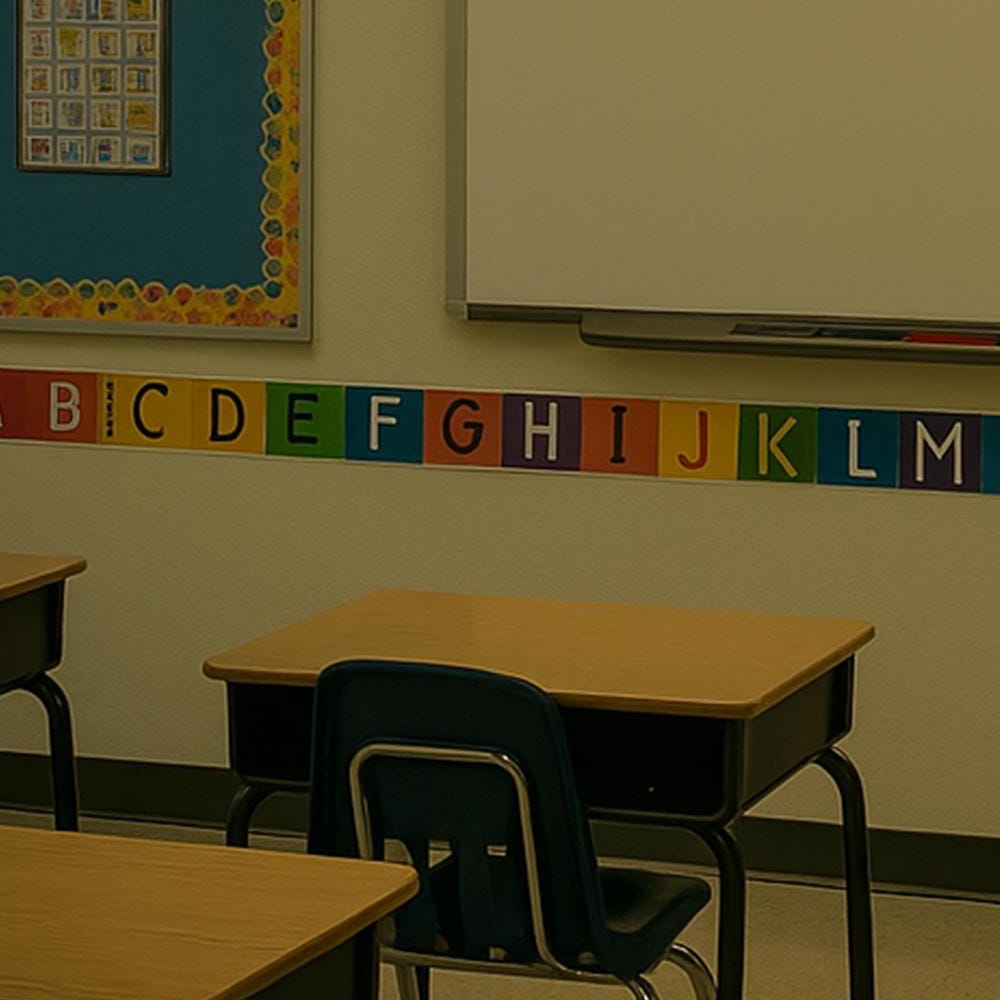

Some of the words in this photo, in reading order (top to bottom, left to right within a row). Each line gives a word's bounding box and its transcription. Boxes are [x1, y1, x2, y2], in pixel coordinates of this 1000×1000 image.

[50, 381, 81, 432] B
[133, 383, 169, 439] C
[209, 388, 245, 441] D
[287, 393, 318, 444] E
[370, 395, 400, 450] F
[443, 399, 483, 455] G
[524, 401, 557, 460] H
[610, 406, 627, 463] I
[678, 411, 707, 470] J
[758, 413, 797, 477] K
[848, 419, 877, 477] L
[916, 420, 962, 485] M
